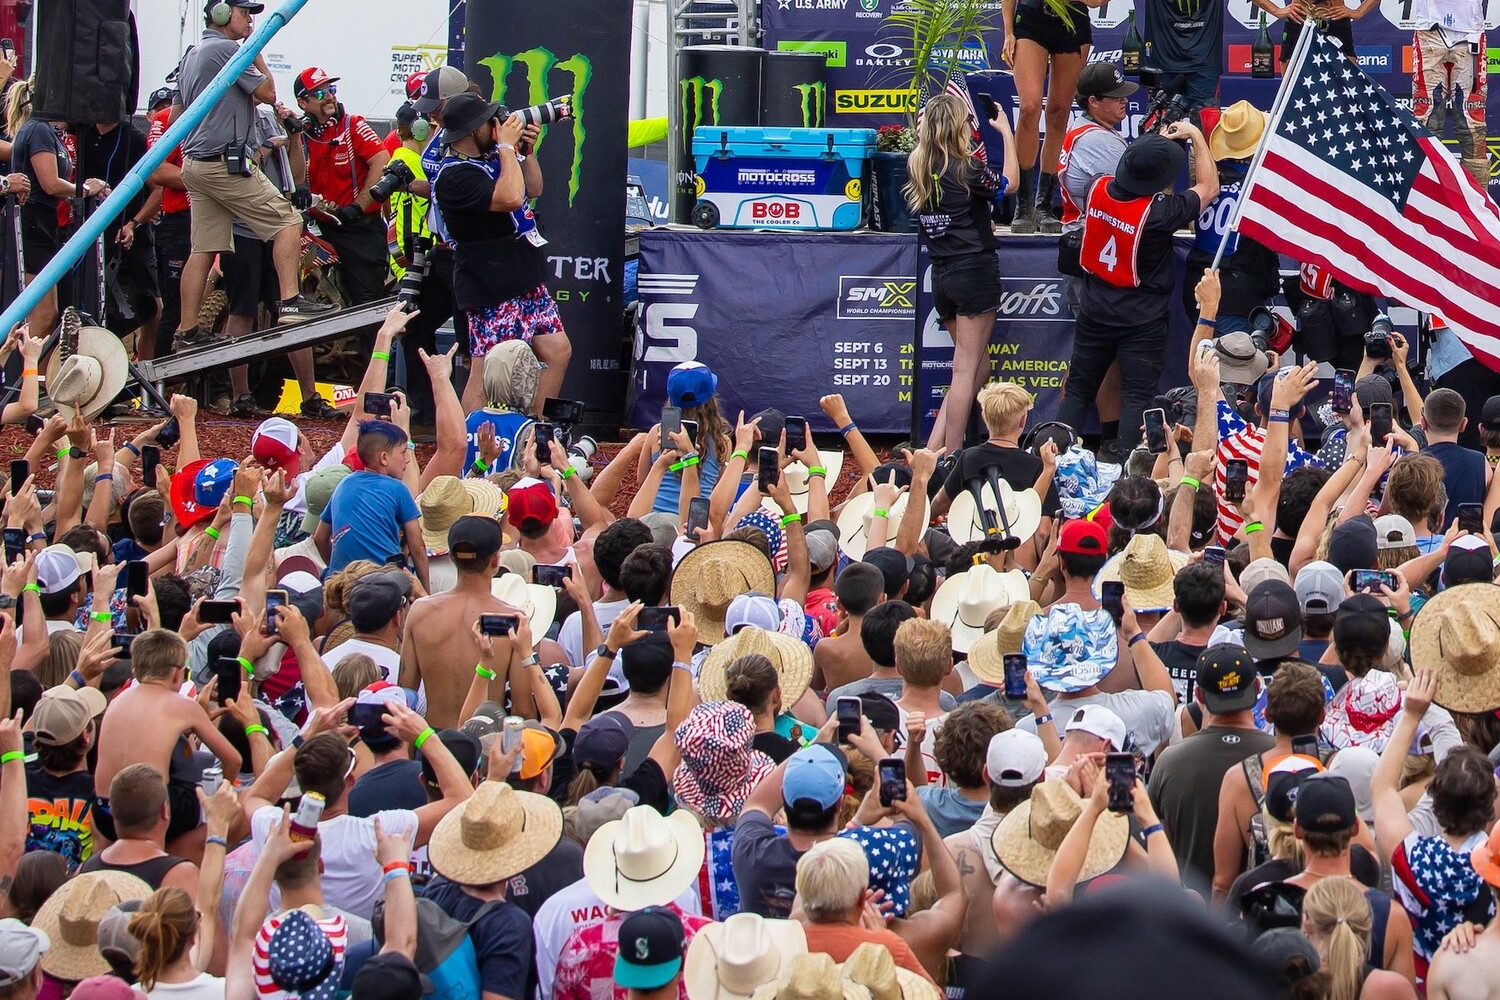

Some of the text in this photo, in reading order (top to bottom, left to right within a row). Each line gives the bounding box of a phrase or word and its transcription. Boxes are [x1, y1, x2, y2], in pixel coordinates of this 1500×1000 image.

[795, 0, 848, 10] U.S. ARMY
[392, 53, 423, 64] SUPER
[1089, 49, 1123, 62] UFO
[393, 63, 421, 73] MOTO
[856, 58, 912, 66] OAKLEY
[837, 94, 917, 109] SUZUK
[738, 172, 816, 182] MOTOCROSS
[752, 202, 801, 218] BOB
[1089, 207, 1135, 235] ALPINESTARS
[1099, 234, 1118, 272] 4
[847, 282, 917, 308] SMX
[834, 342, 884, 354] SEPT 6
[834, 358, 887, 370] SEPT 13
[833, 374, 890, 386] SEPT 20
[1256, 617, 1285, 635] INDIAN
